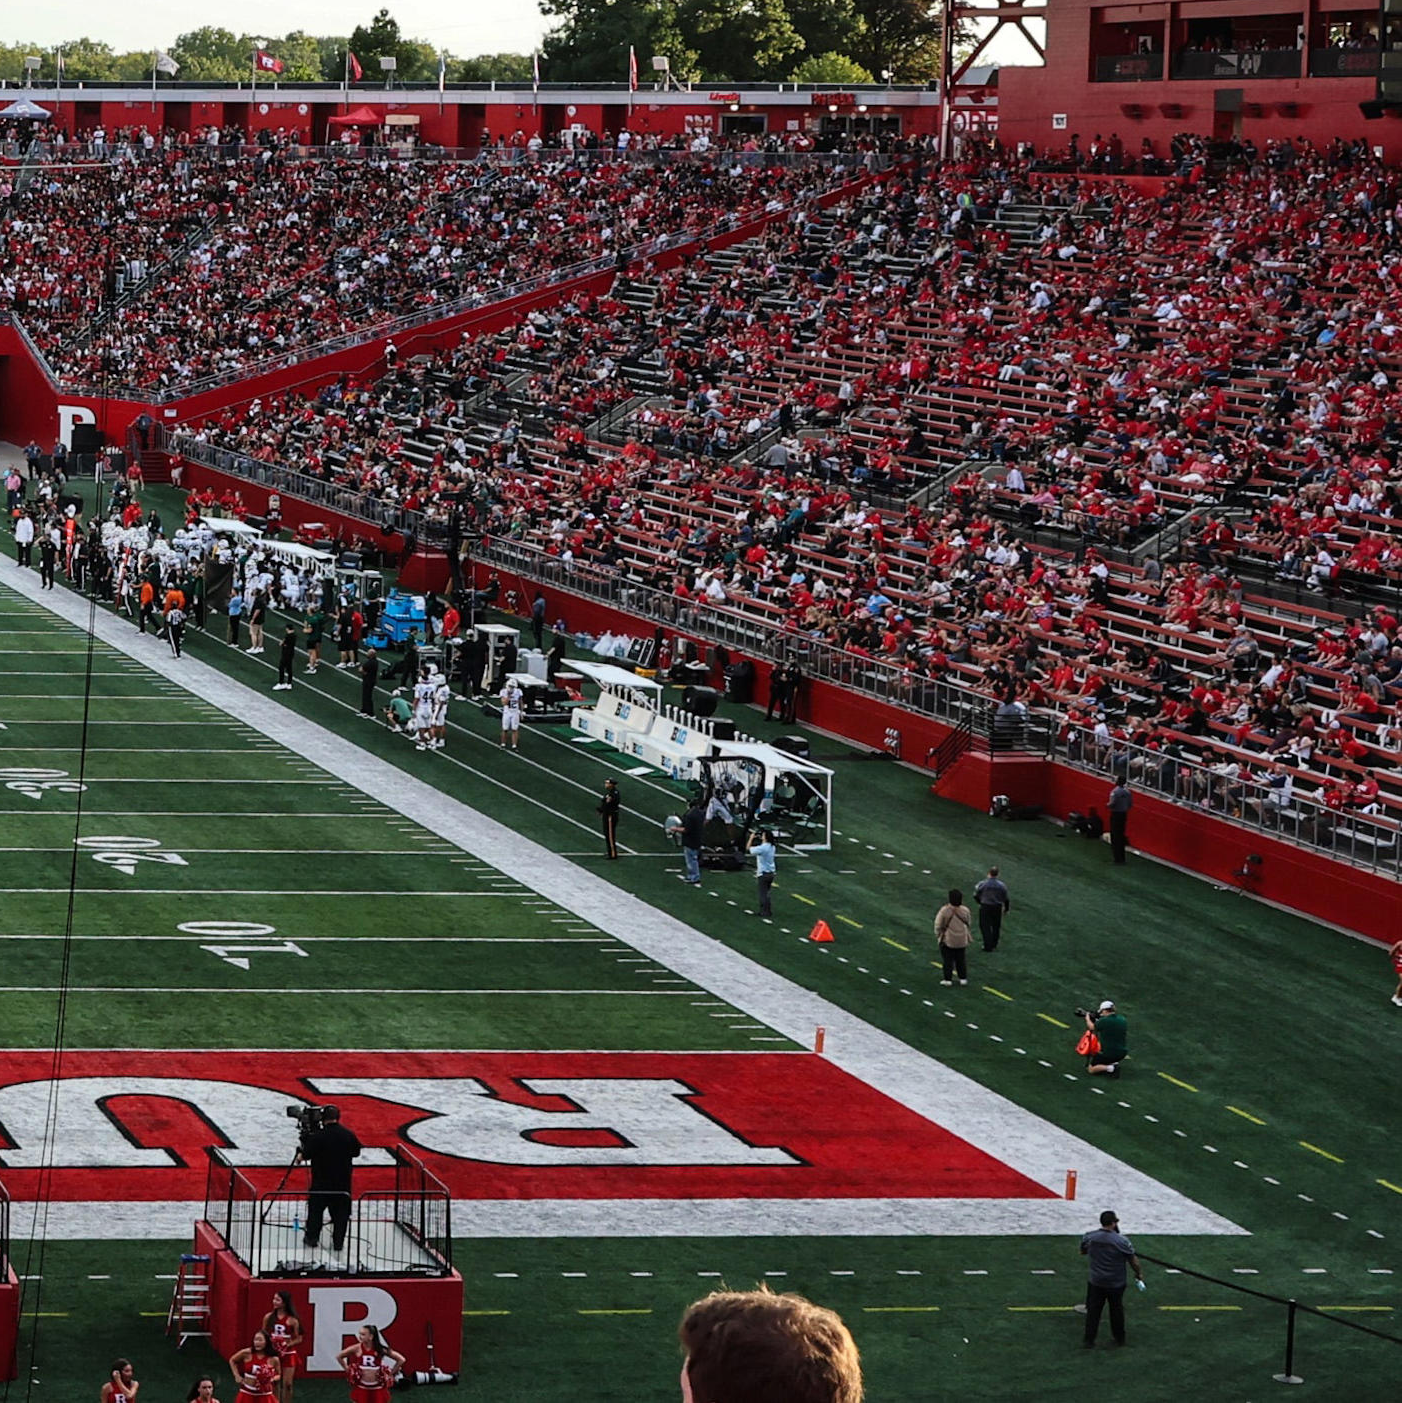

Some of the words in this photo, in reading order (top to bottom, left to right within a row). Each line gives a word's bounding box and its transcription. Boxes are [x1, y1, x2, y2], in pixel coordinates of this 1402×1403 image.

[72, 836, 190, 866] 20
[176, 920, 309, 958] 10
[274, 1323, 286, 1336] R
[305, 1286, 398, 1372] R
[362, 1354, 376, 1367] R
